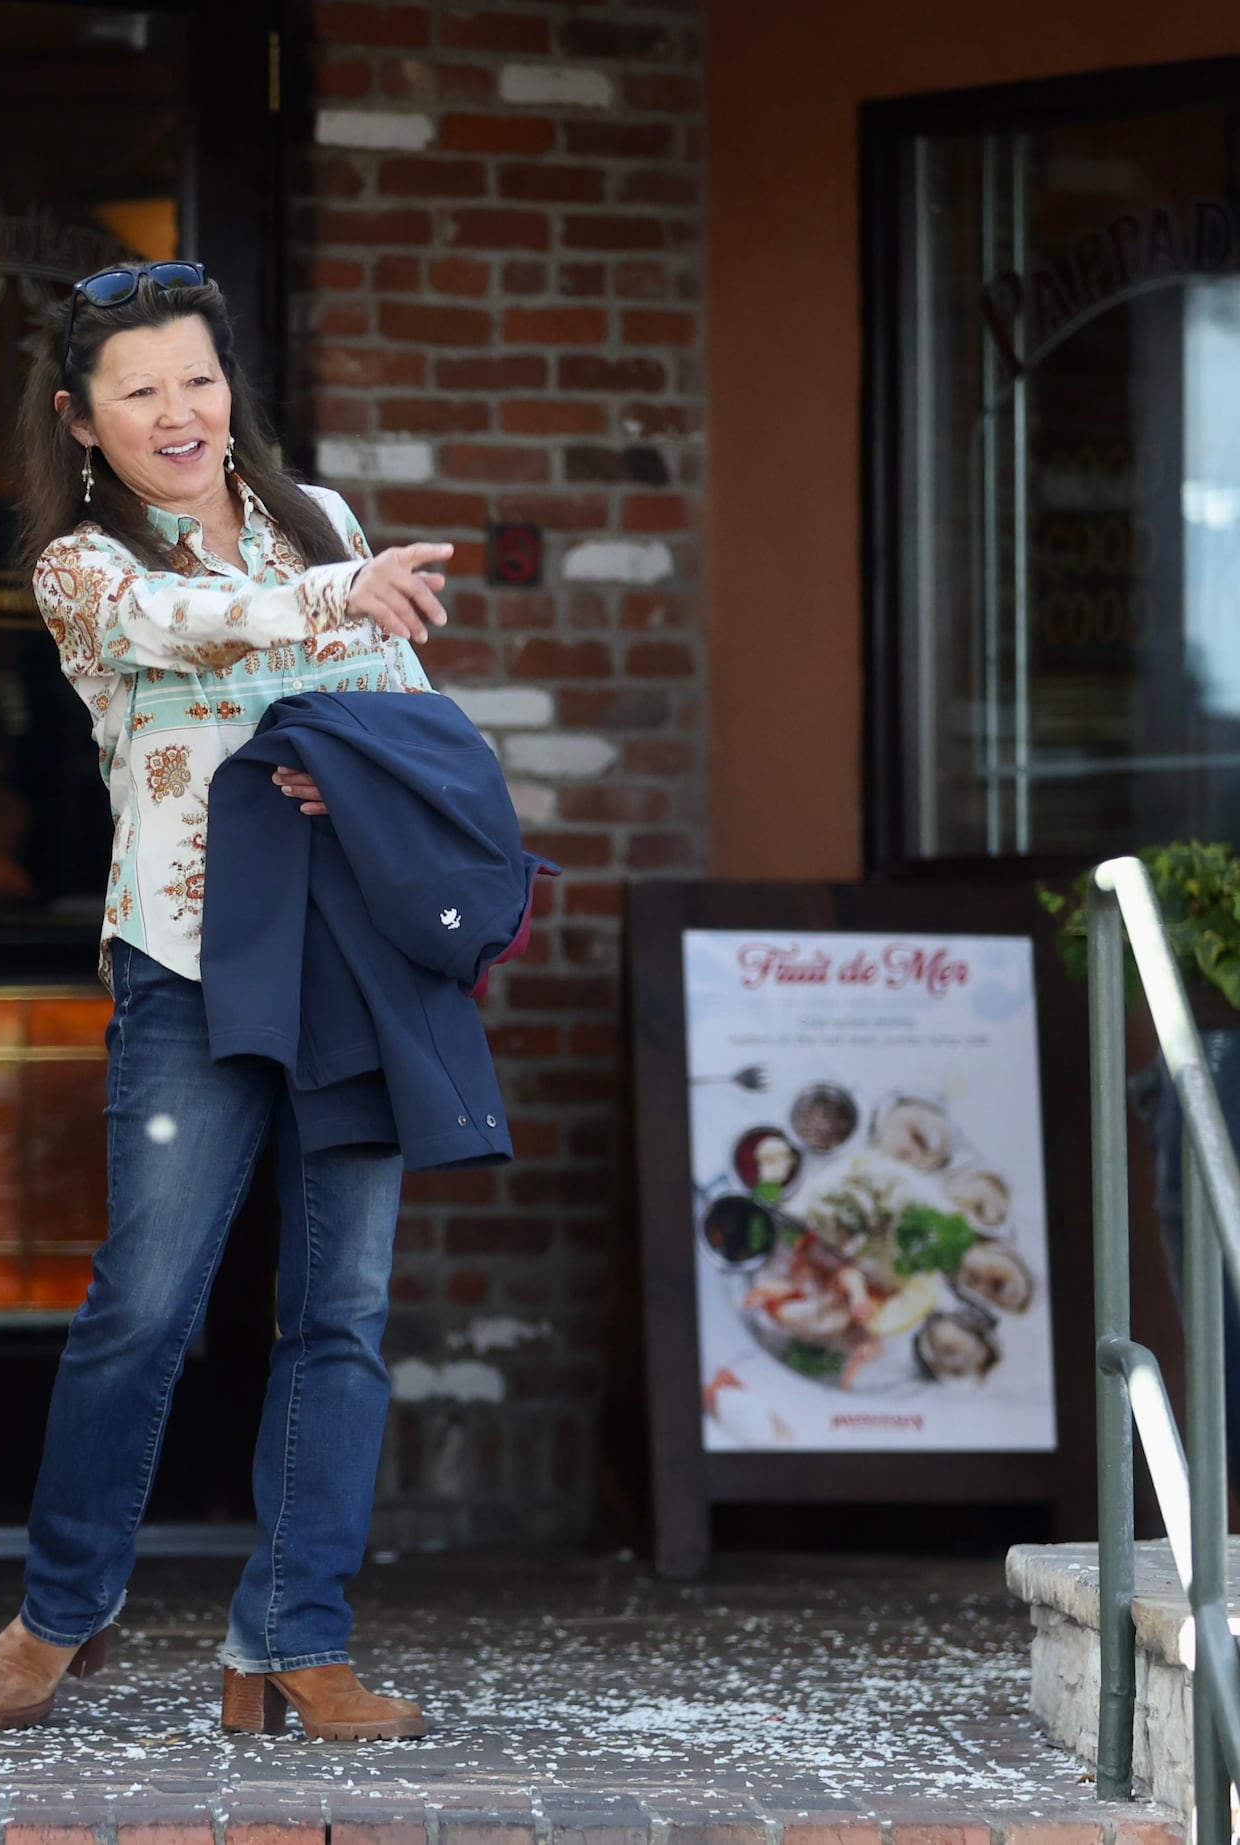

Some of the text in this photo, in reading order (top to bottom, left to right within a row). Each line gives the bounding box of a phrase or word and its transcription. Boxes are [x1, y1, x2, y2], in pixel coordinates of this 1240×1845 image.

[977, 197, 1240, 378] PAPPAD
[838, 946, 879, 986] de
[881, 941, 970, 1001] Mer
